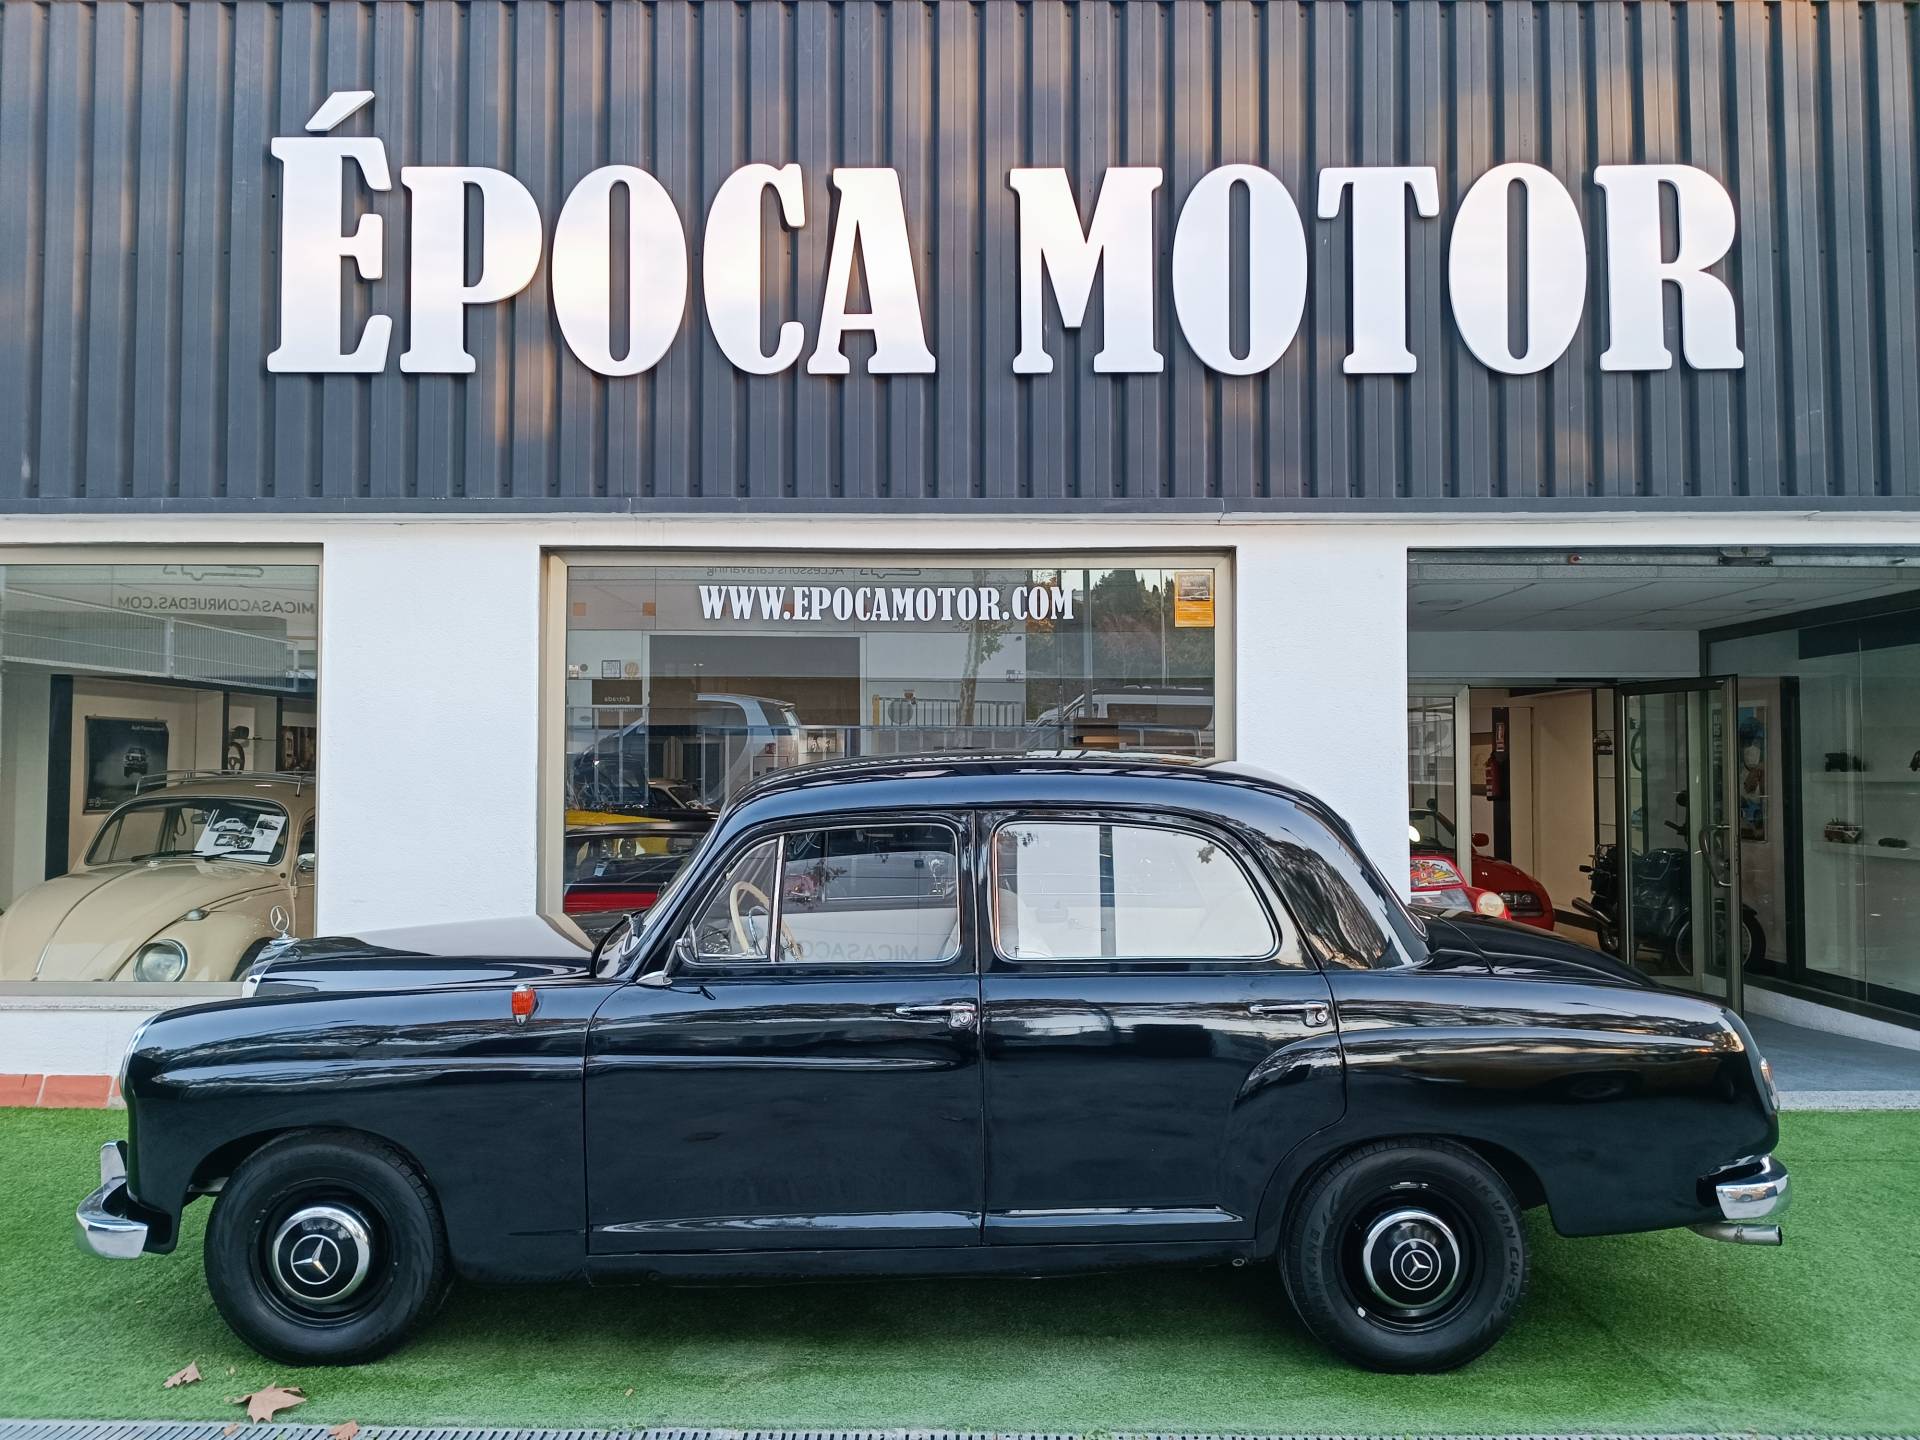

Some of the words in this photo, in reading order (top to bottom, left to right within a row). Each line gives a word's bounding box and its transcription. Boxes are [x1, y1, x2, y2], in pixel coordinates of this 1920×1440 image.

[266, 90, 937, 377] ÉPOCA
[1009, 162, 1745, 375] MOTOR
[698, 585, 1075, 622] WWW.EPOCAMOTOR.COM
